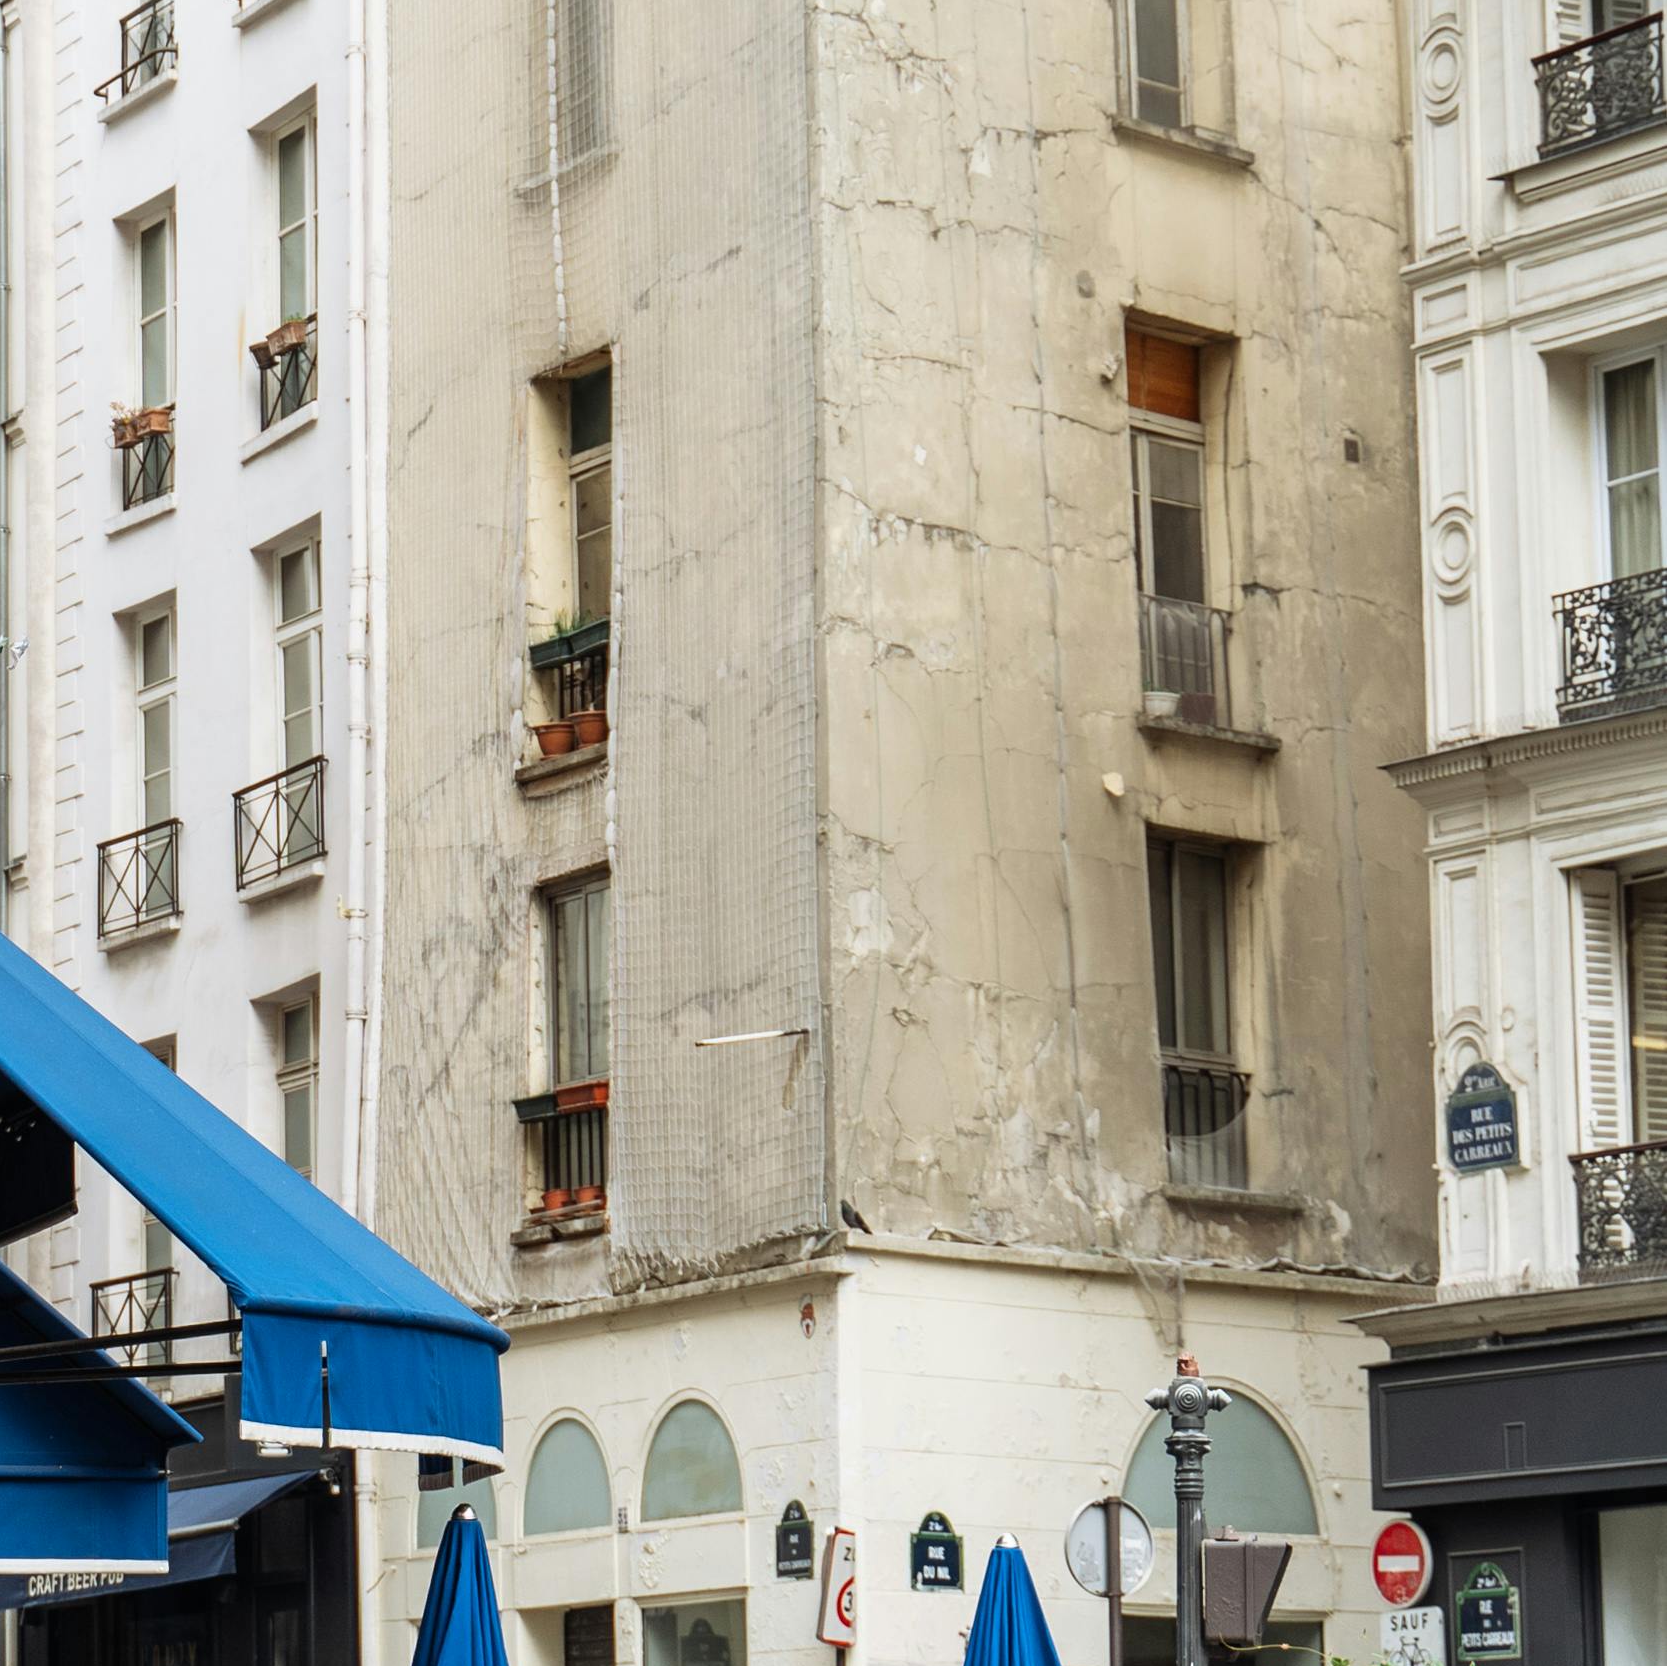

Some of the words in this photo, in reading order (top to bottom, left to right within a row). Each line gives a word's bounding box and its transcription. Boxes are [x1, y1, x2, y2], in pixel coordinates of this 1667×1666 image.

[1470, 1106, 1494, 1123] RUE
[1453, 1128, 1473, 1145] DES
[1475, 1122, 1513, 1141] PETITS
[1454, 1140, 1513, 1163] CARREAUX
[928, 1545, 946, 1561] RUE
[922, 1565, 936, 1579] DU
[937, 1565, 952, 1581] NIL
[28, 1573, 66, 1597] CRAFT
[67, 1573, 98, 1591] BEER
[1390, 1613, 1429, 1632] SAUF
